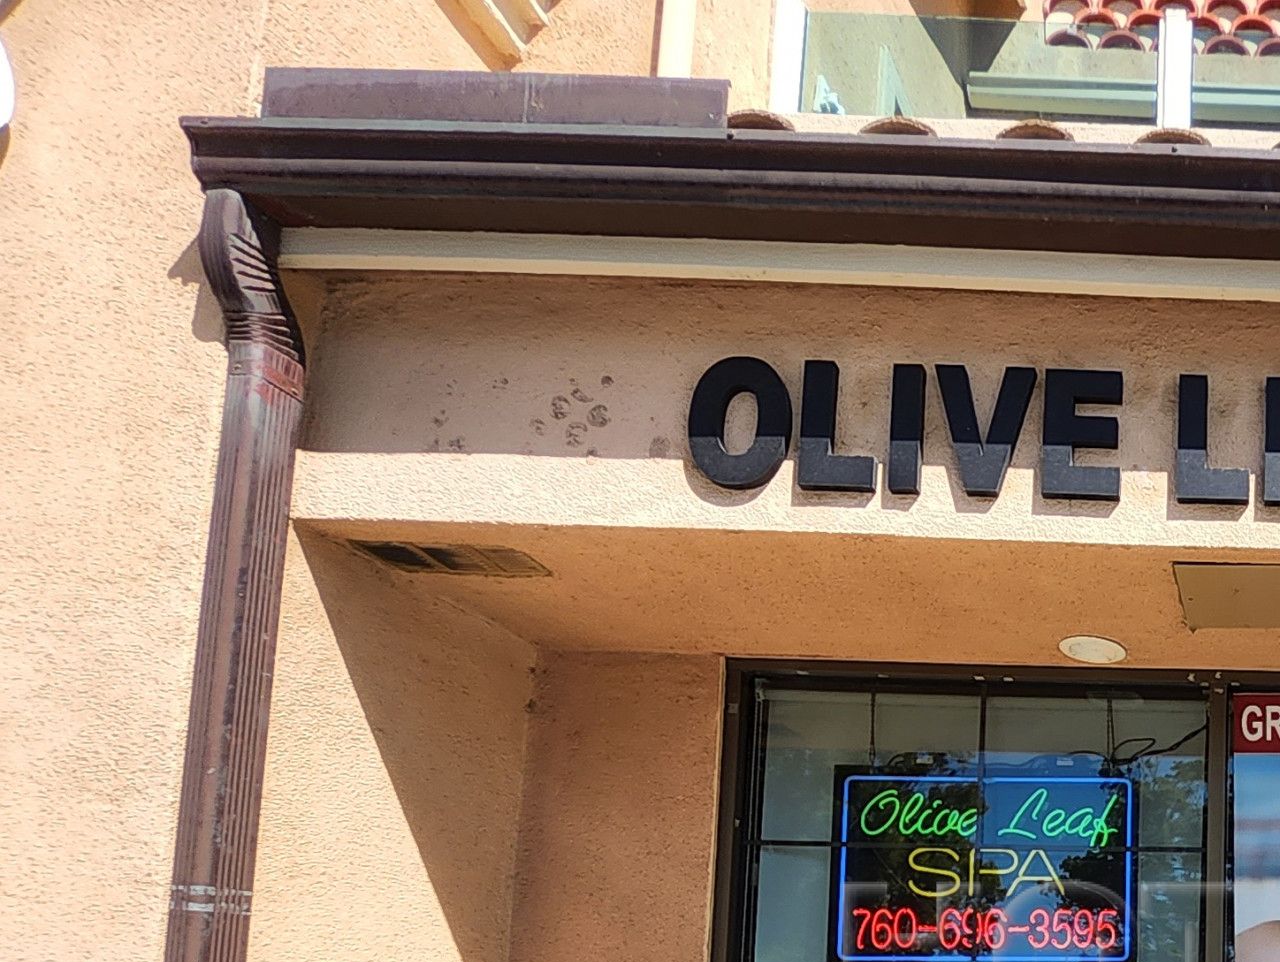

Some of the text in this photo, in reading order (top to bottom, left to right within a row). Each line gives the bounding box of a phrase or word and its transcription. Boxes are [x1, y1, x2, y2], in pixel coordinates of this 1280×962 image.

[688, 356, 1123, 500] OLIVE
[861, 788, 1118, 847] Olive Leaf
[908, 848, 1065, 897] SPA
[853, 907, 1119, 950] 760-696-3595
